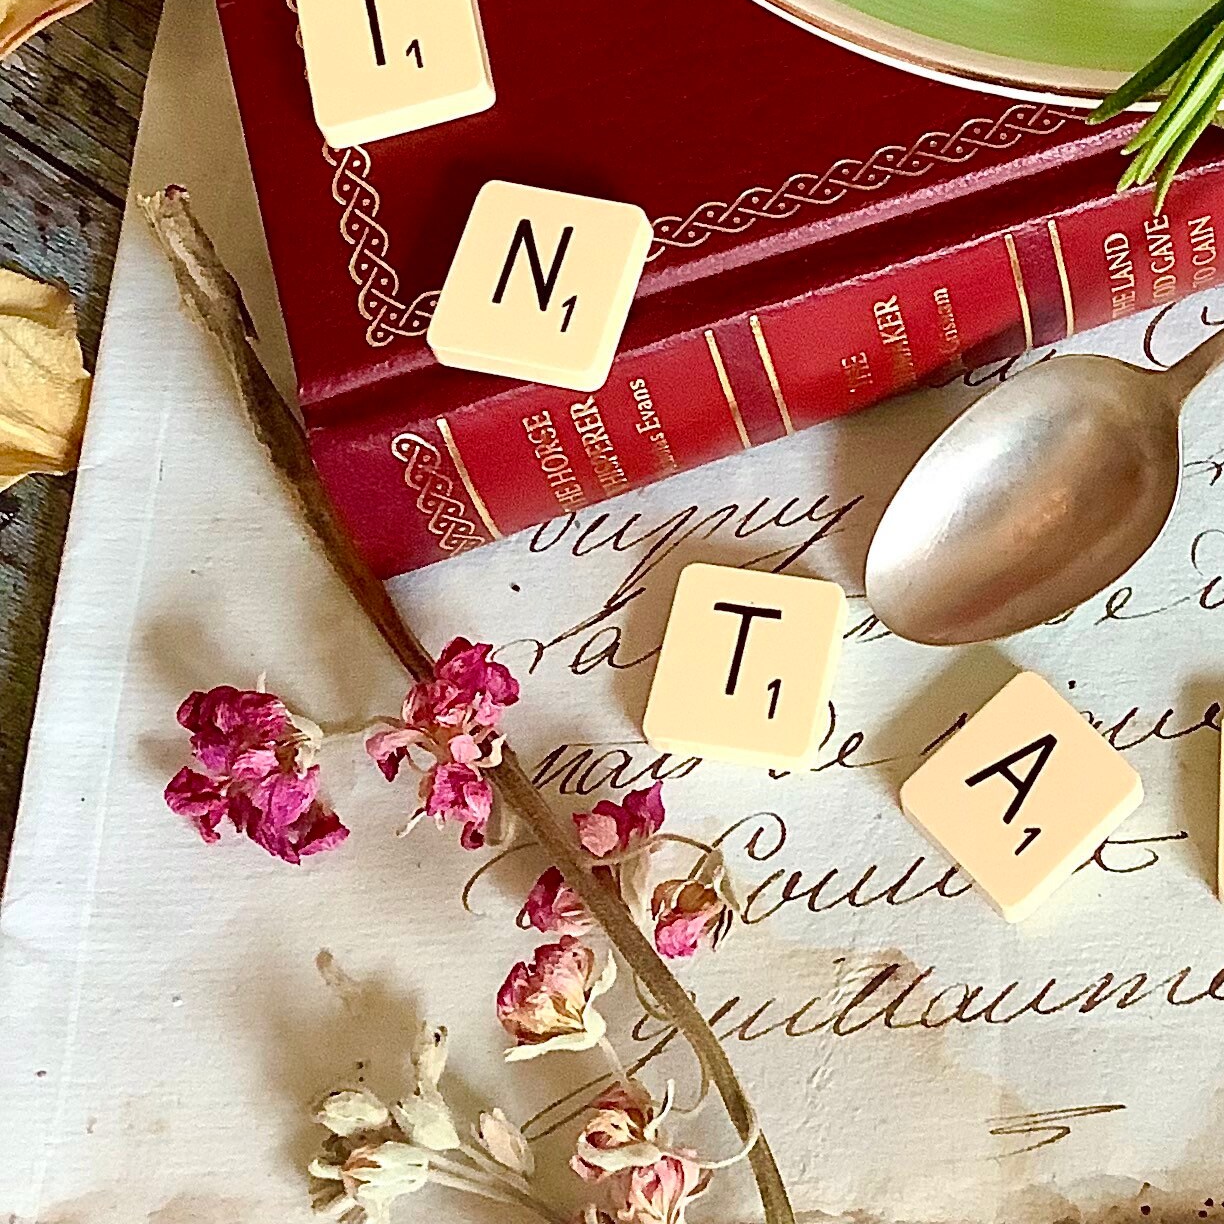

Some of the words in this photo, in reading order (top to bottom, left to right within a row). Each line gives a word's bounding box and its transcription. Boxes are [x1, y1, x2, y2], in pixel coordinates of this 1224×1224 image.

[1102, 231, 1135, 293] LAND
[1143, 214, 1175, 273] GAVE
[1187, 215, 1216, 265] CAIN
[628, 376, 660, 434] Evans
[523, 410, 574, 485] HORSE
